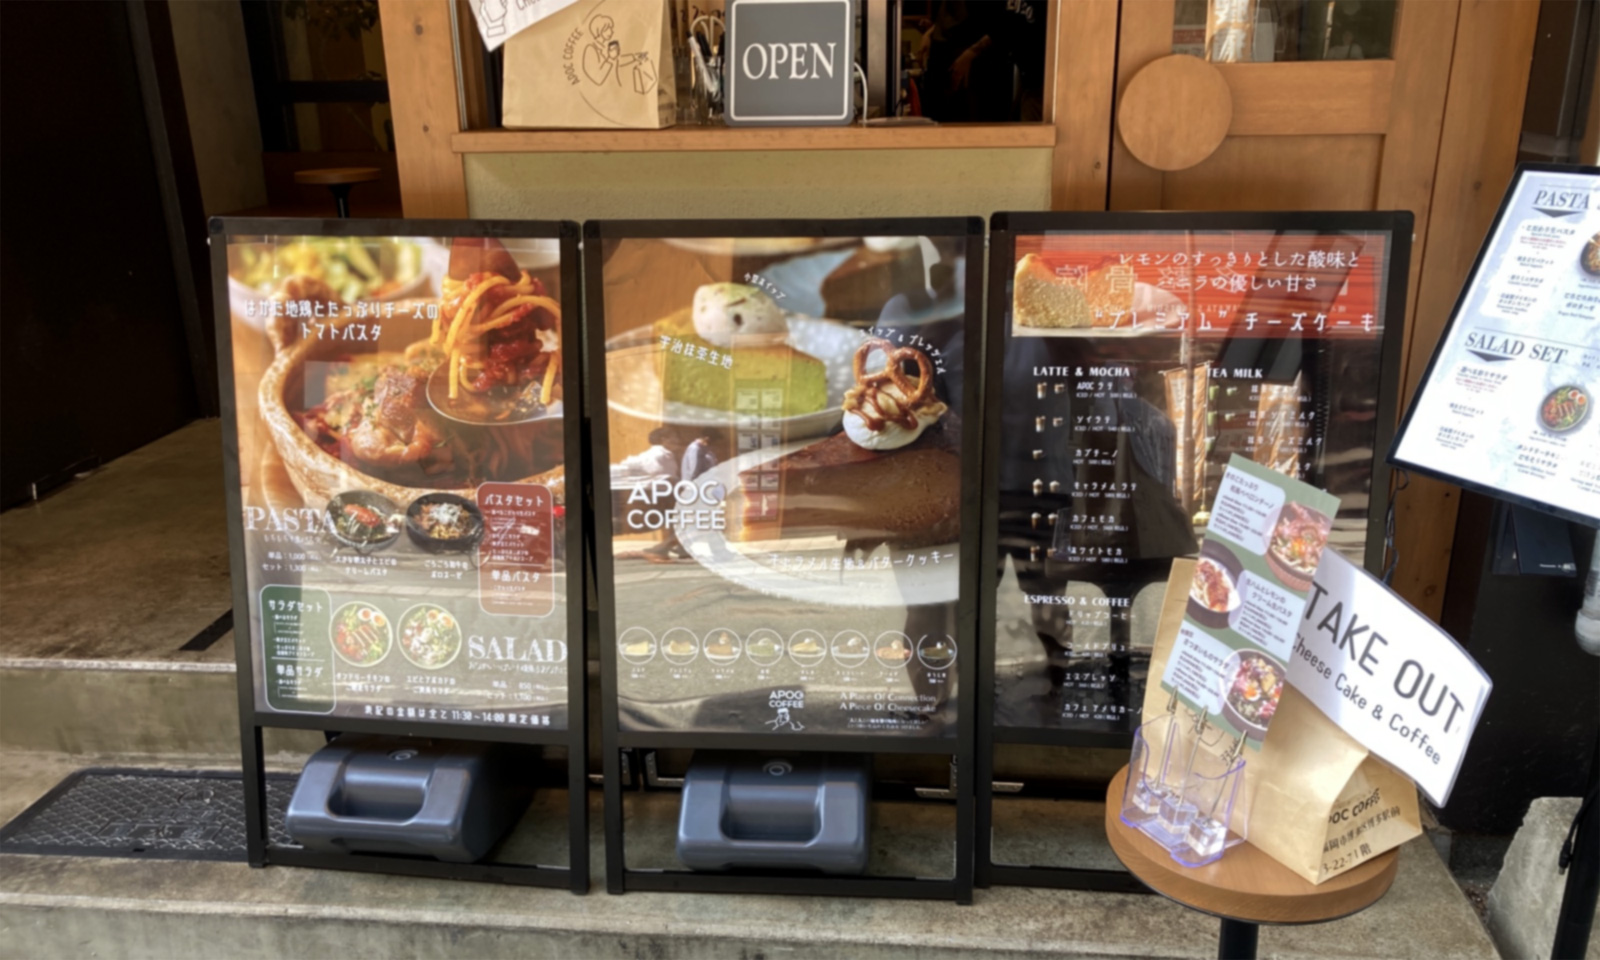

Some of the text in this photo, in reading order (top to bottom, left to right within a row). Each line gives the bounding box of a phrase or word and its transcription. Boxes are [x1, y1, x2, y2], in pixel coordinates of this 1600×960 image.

[562, 27, 584, 61] COFFEE
[743, 42, 837, 80] OPEN
[1533, 190, 1590, 210] PASTA
[1119, 250, 1360, 269] レモンのすっきりとした酸味と
[245, 299, 439, 320] はかた地鶏とたっぷりチーズの
[301, 322, 382, 341] トマトパスタ
[1465, 331, 1525, 356] SALAD
[1529, 343, 1568, 365] SET
[1033, 366, 1130, 377] LATTE & MOCHA
[1207, 368, 1263, 379] TEA MILK
[484, 494, 544, 507] パスタセット
[245, 506, 338, 535] PASTA
[627, 509, 725, 529] COFFEE
[491, 570, 541, 583] 単品パスタ
[268, 600, 323, 612] サラダセット
[1024, 595, 1130, 607] ESPRESSO & COFFEE
[468, 635, 568, 663] SALAD
[1312, 581, 1389, 676] TAKE
[1393, 659, 1465, 734] OUT
[276, 665, 323, 677] 単品サラダ
[1065, 673, 1116, 682] エスプレッソ
[768, 700, 804, 708] COFFEE
[840, 692, 848, 700] A
[887, 693, 936, 702] Connection
[840, 702, 848, 711] A
[850, 703, 871, 711] Piece
[887, 703, 936, 712] Cheesecake
[1334, 673, 1367, 710] Cake
[1371, 704, 1384, 721] &
[1388, 713, 1441, 765] Coffee
